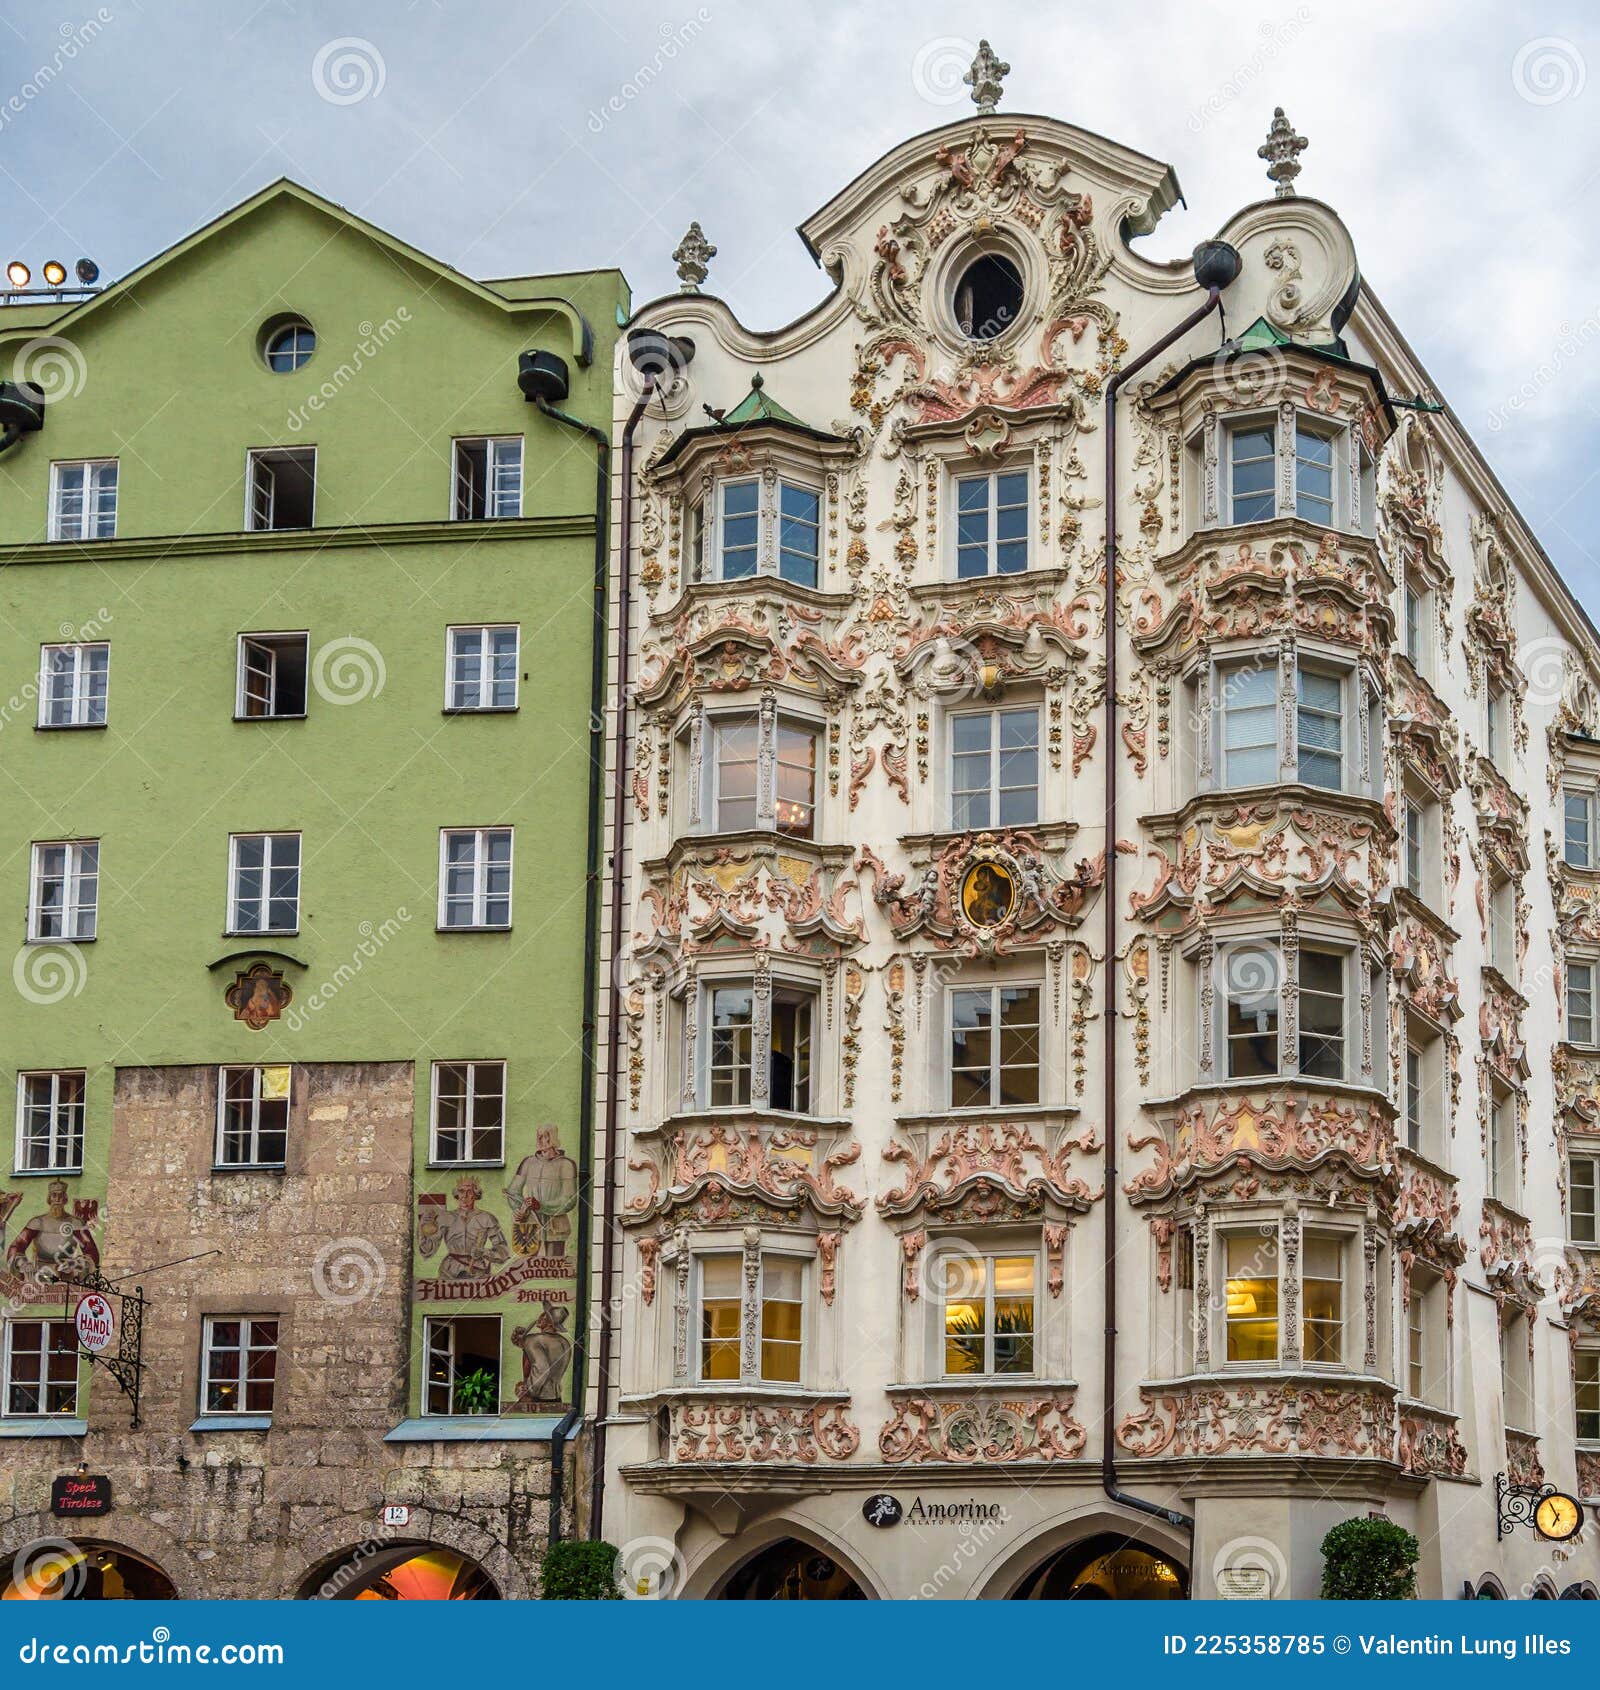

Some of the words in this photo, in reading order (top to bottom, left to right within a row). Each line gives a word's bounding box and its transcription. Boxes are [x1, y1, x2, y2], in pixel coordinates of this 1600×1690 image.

[80, 1313, 110, 1336] HANDL
[65, 1480, 97, 1495] Speck
[60, 1496, 103, 1509] Tirolese
[907, 1495, 1001, 1519] Amorino
[390, 1507, 403, 1520] 12
